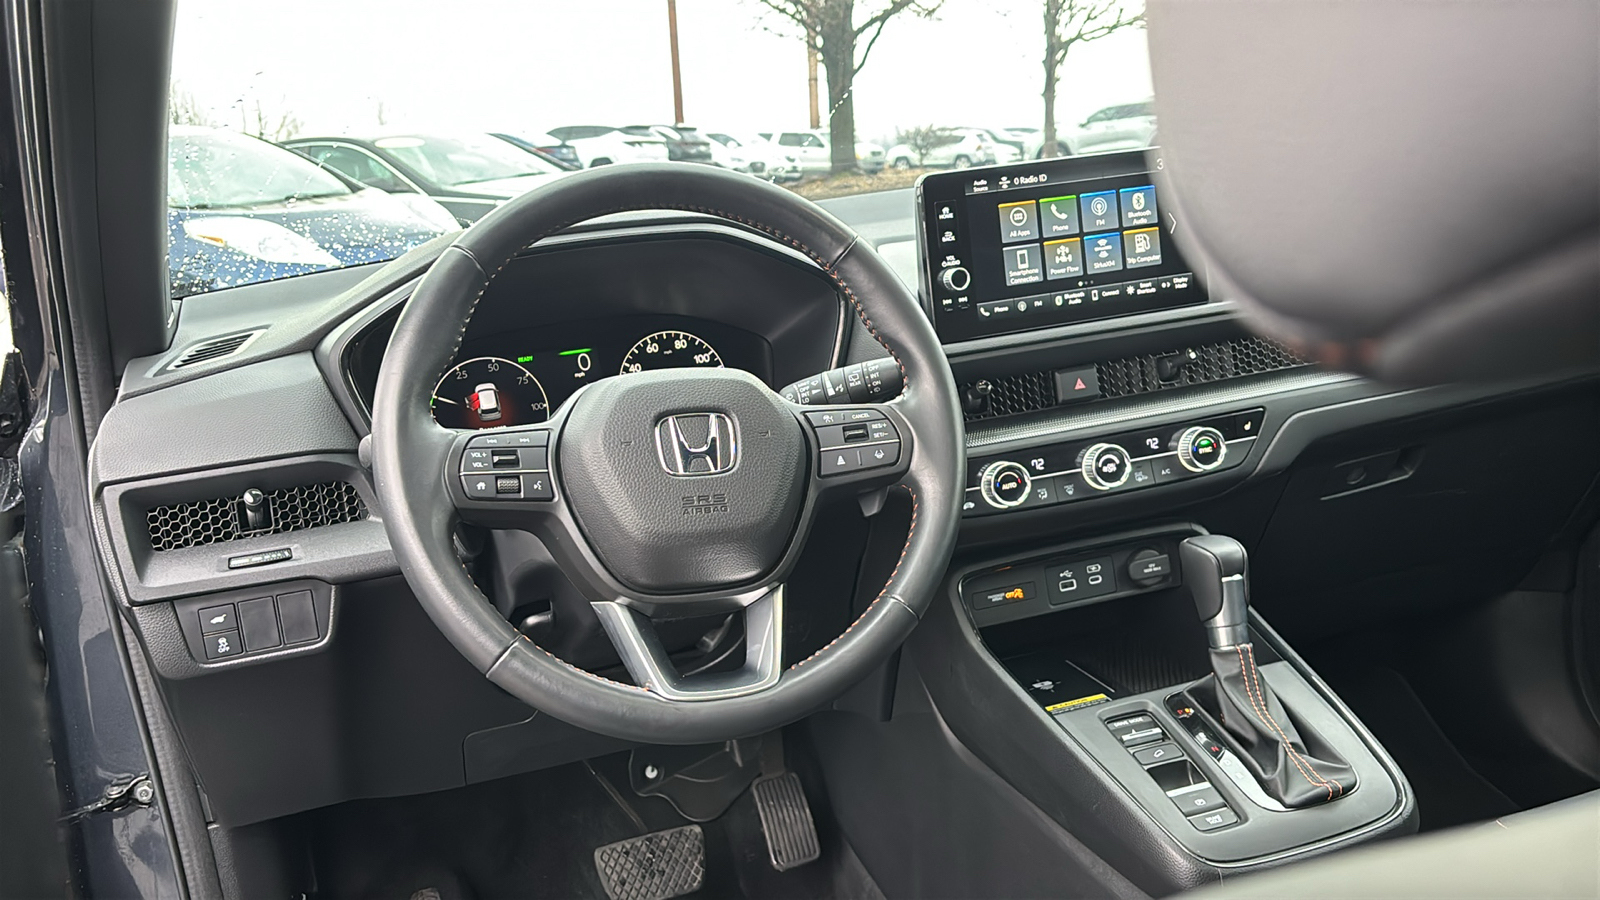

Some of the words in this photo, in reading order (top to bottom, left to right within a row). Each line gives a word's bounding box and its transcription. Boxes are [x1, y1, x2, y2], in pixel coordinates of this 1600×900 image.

[1020, 175, 1038, 185] Radio
[1039, 173, 1048, 183] ID
[939, 212, 954, 220] HOME
[1127, 209, 1151, 219] Bluetooth
[1132, 217, 1148, 225] Audio
[1052, 224, 1069, 232] Phone
[1018, 229, 1031, 238] Apps
[1127, 256, 1136, 265] Trip
[1137, 254, 1161, 263] Computer
[1009, 268, 1039, 279] Smartphone
[1050, 266, 1066, 275] Power
[1067, 265, 1080, 273] Flow
[1010, 276, 1039, 285] Connection
[1064, 291, 1085, 300] Bluetooth
[1102, 289, 1120, 297] Connect
[994, 305, 1009, 313] Phone
[646, 343, 659, 354] 60
[674, 339, 688, 350] 80
[517, 355, 534, 363] READY
[577, 353, 591, 371] 0
[693, 353, 711, 364] 100
[488, 361, 500, 373] 50
[629, 363, 642, 373] 40
[456, 369, 468, 380] 25
[516, 375, 529, 386] 75
[530, 402, 545, 411] 100
[1146, 437, 1159, 450] 72
[1031, 458, 1045, 470] 72
[1161, 468, 1171, 476] A/C
[1002, 481, 1018, 491] AUTO
[682, 494, 727, 506] SRS
[682, 505, 730, 516] AIRBAG
